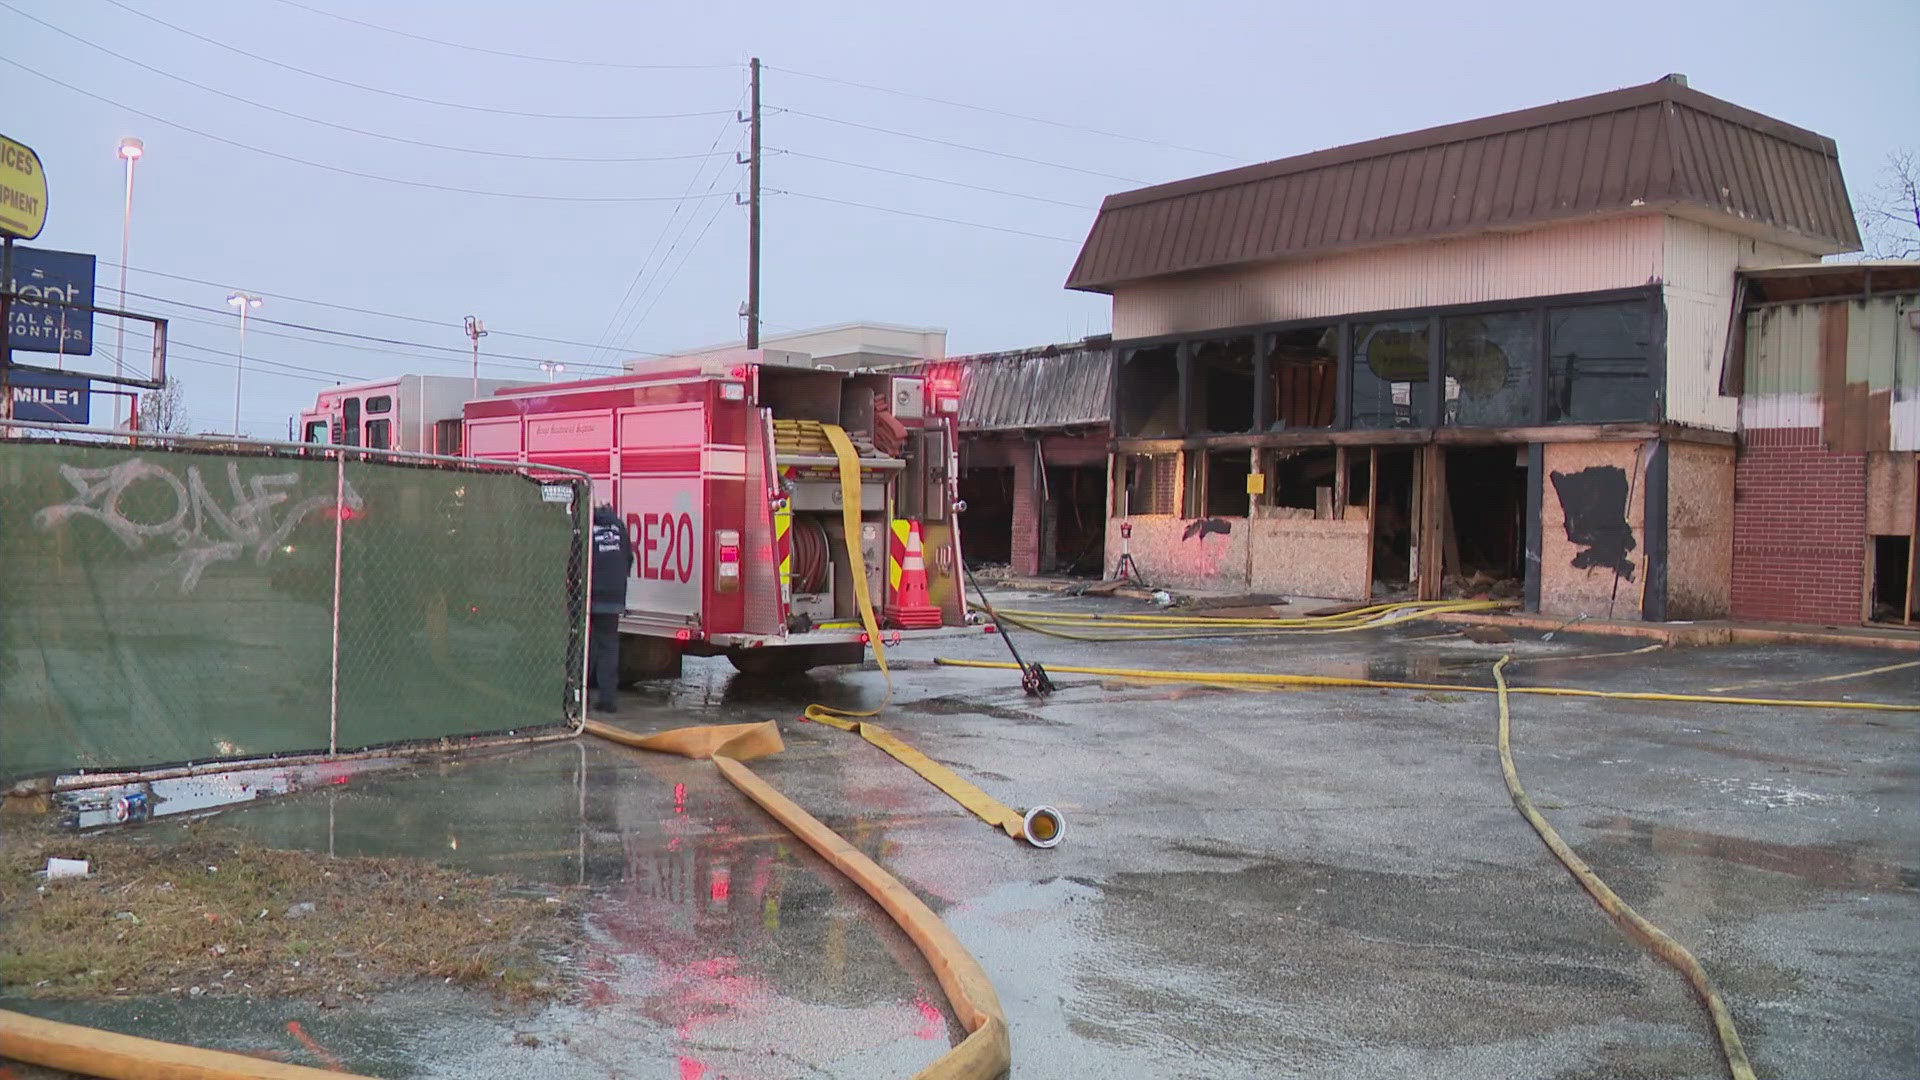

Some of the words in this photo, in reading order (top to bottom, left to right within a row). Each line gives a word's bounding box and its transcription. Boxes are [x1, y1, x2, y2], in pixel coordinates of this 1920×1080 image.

[0, 143, 33, 175] ICES
[44, 314, 54, 326] &
[13, 387, 79, 405] MILE1
[627, 512, 694, 583] RE20
